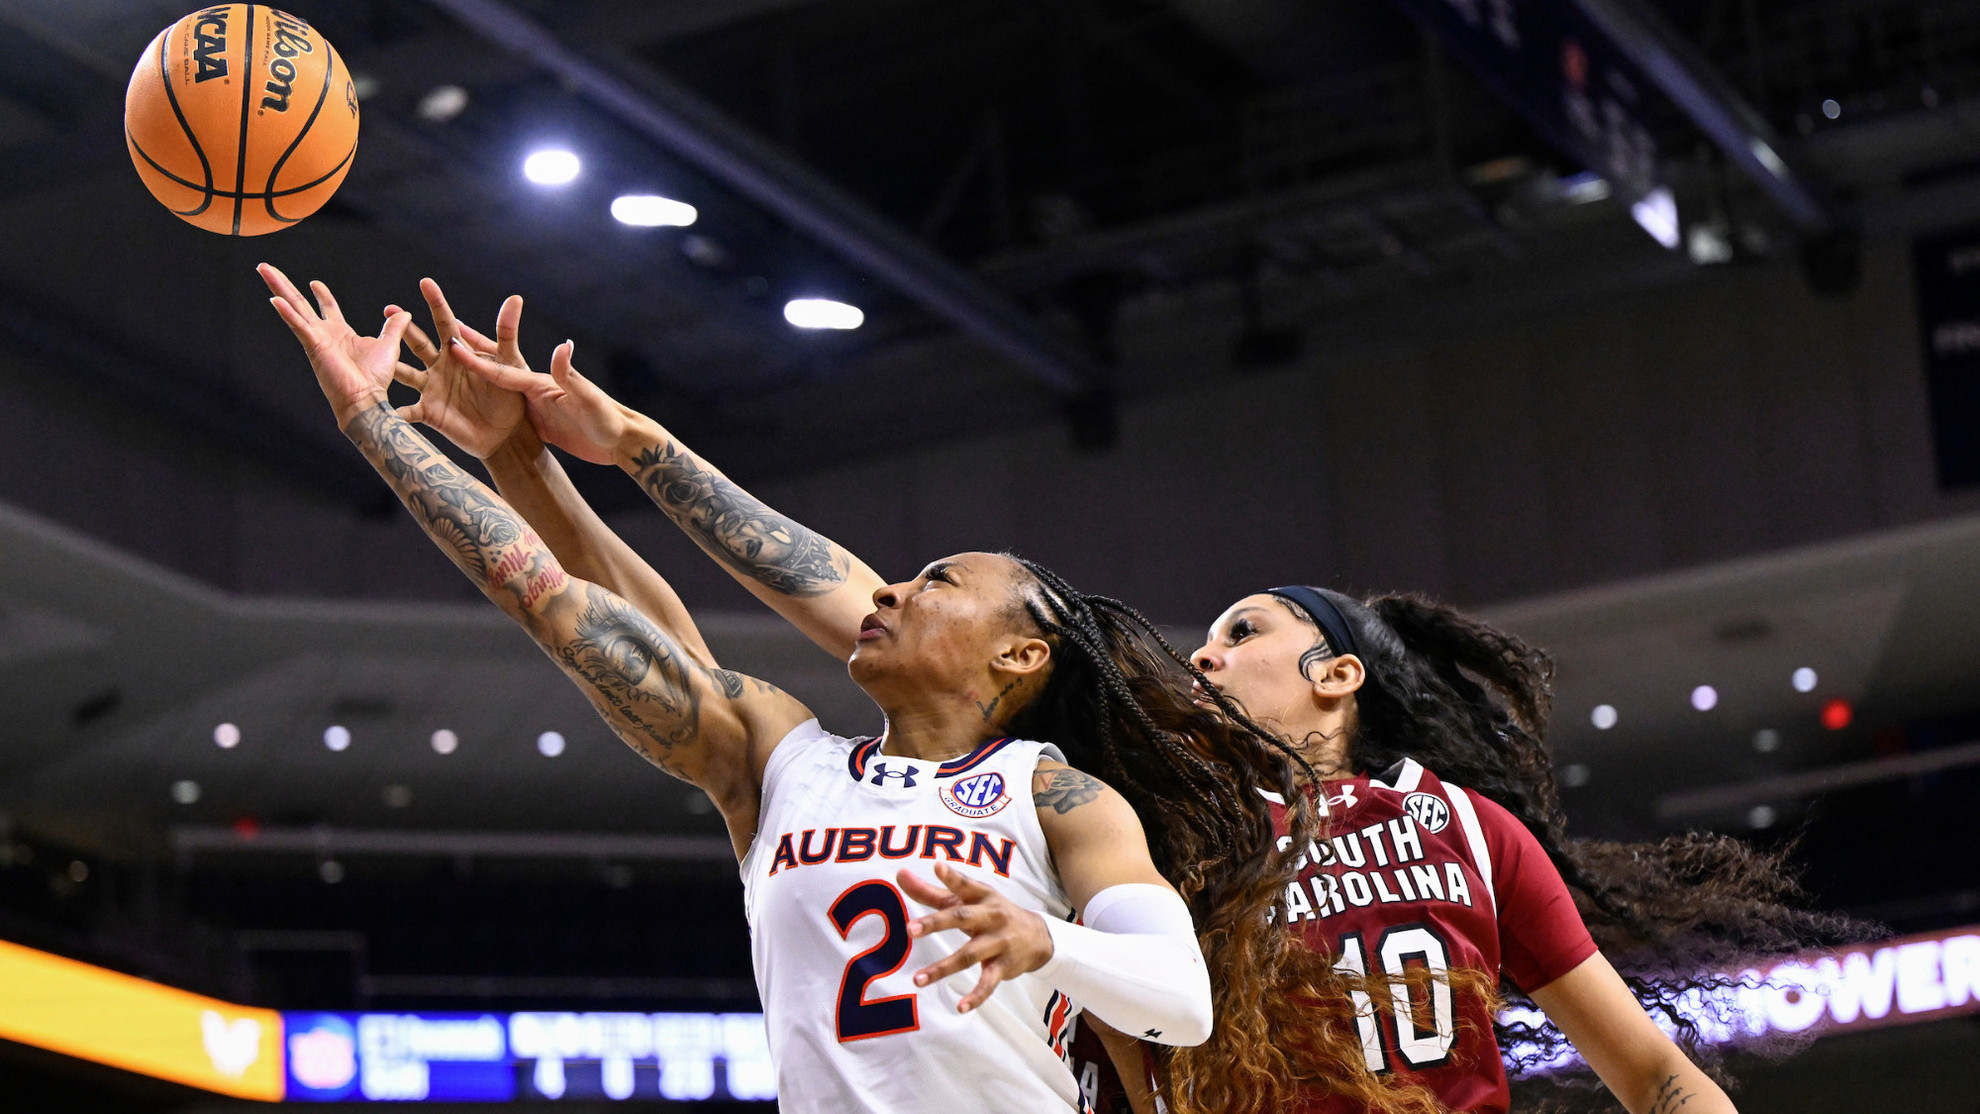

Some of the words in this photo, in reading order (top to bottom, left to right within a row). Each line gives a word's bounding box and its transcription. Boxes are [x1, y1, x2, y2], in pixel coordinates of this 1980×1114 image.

[193, 7, 231, 83] NCAA
[944, 797, 999, 816] GRADUATE
[954, 774, 1001, 807] SEC
[1405, 794, 1449, 832] SEC
[769, 825, 1016, 877] AUBURN
[1267, 861, 1473, 924] AROLINA
[827, 879, 920, 1043] 2
[1333, 924, 1456, 1074] 10
